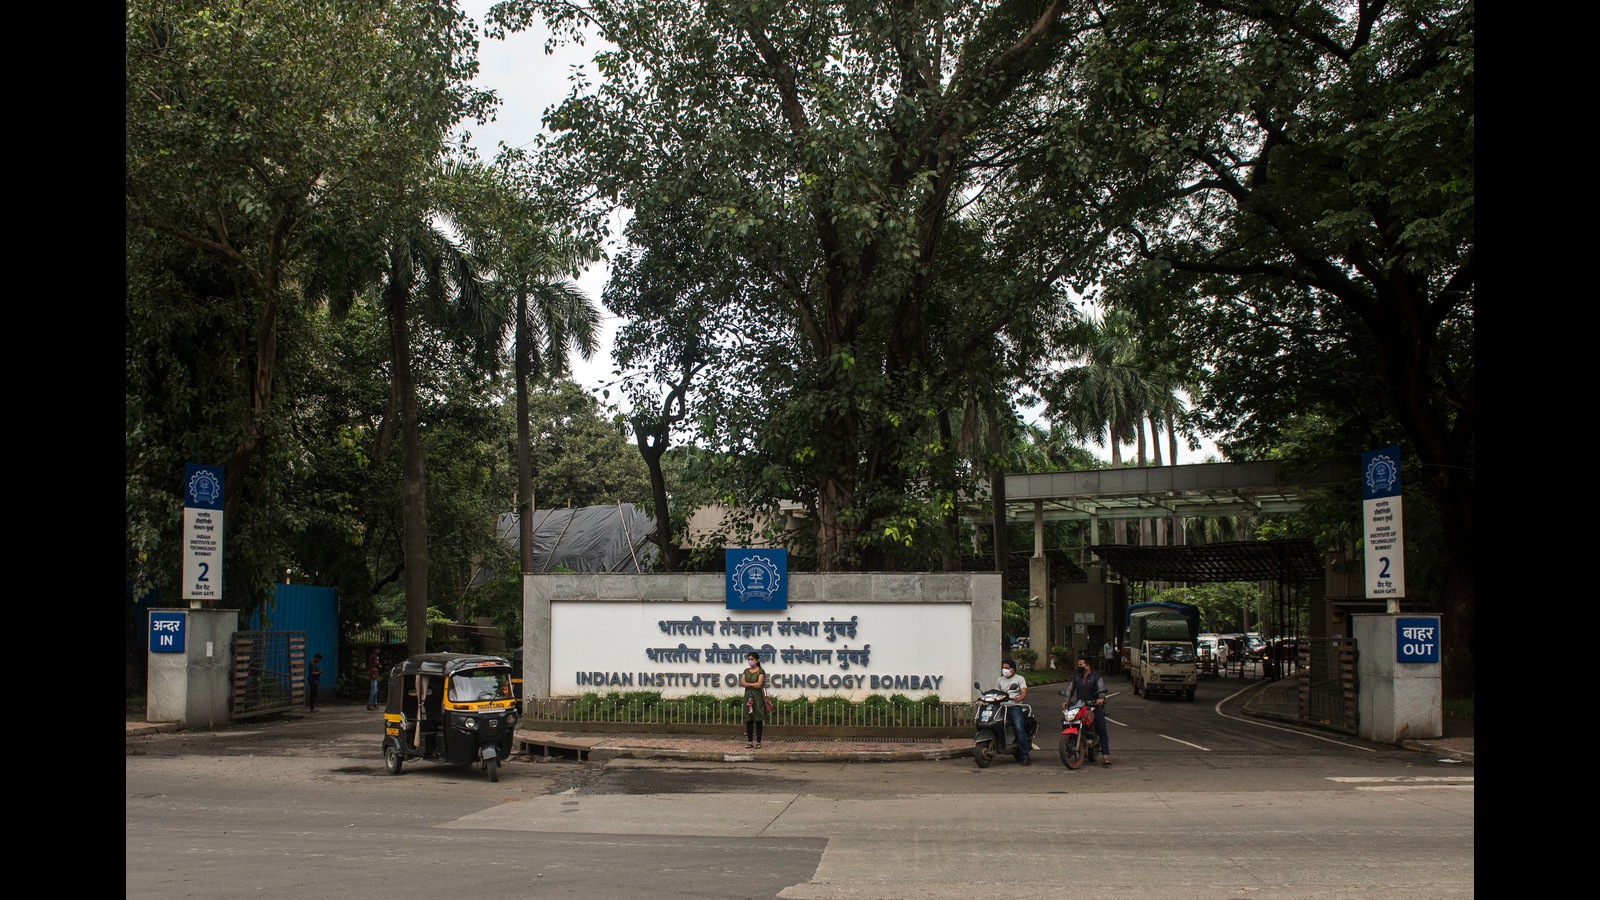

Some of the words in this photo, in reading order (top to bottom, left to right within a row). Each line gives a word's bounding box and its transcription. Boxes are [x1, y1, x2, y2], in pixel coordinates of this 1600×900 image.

[197, 562, 209, 582] 2
[1379, 556, 1390, 578] 2
[153, 620, 181, 632] अन्दर
[658, 616, 716, 636] भारतीय
[719, 616, 774, 638] तंत्रज्ञान
[777, 616, 820, 637] संस्था
[823, 616, 858, 643] मुंबई
[1402, 627, 1434, 641] बाहर
[160, 635, 173, 645] IN
[1403, 644, 1434, 656] OUT
[646, 643, 702, 664] भारतीय
[780, 644, 833, 665] संस्थान
[836, 644, 871, 671] मुंबई
[576, 671, 633, 688] INDIAN
[638, 672, 721, 688] INSTITUTE
[763, 673, 866, 690] ECHNOLOGY
[869, 674, 944, 691] BOMBAY
